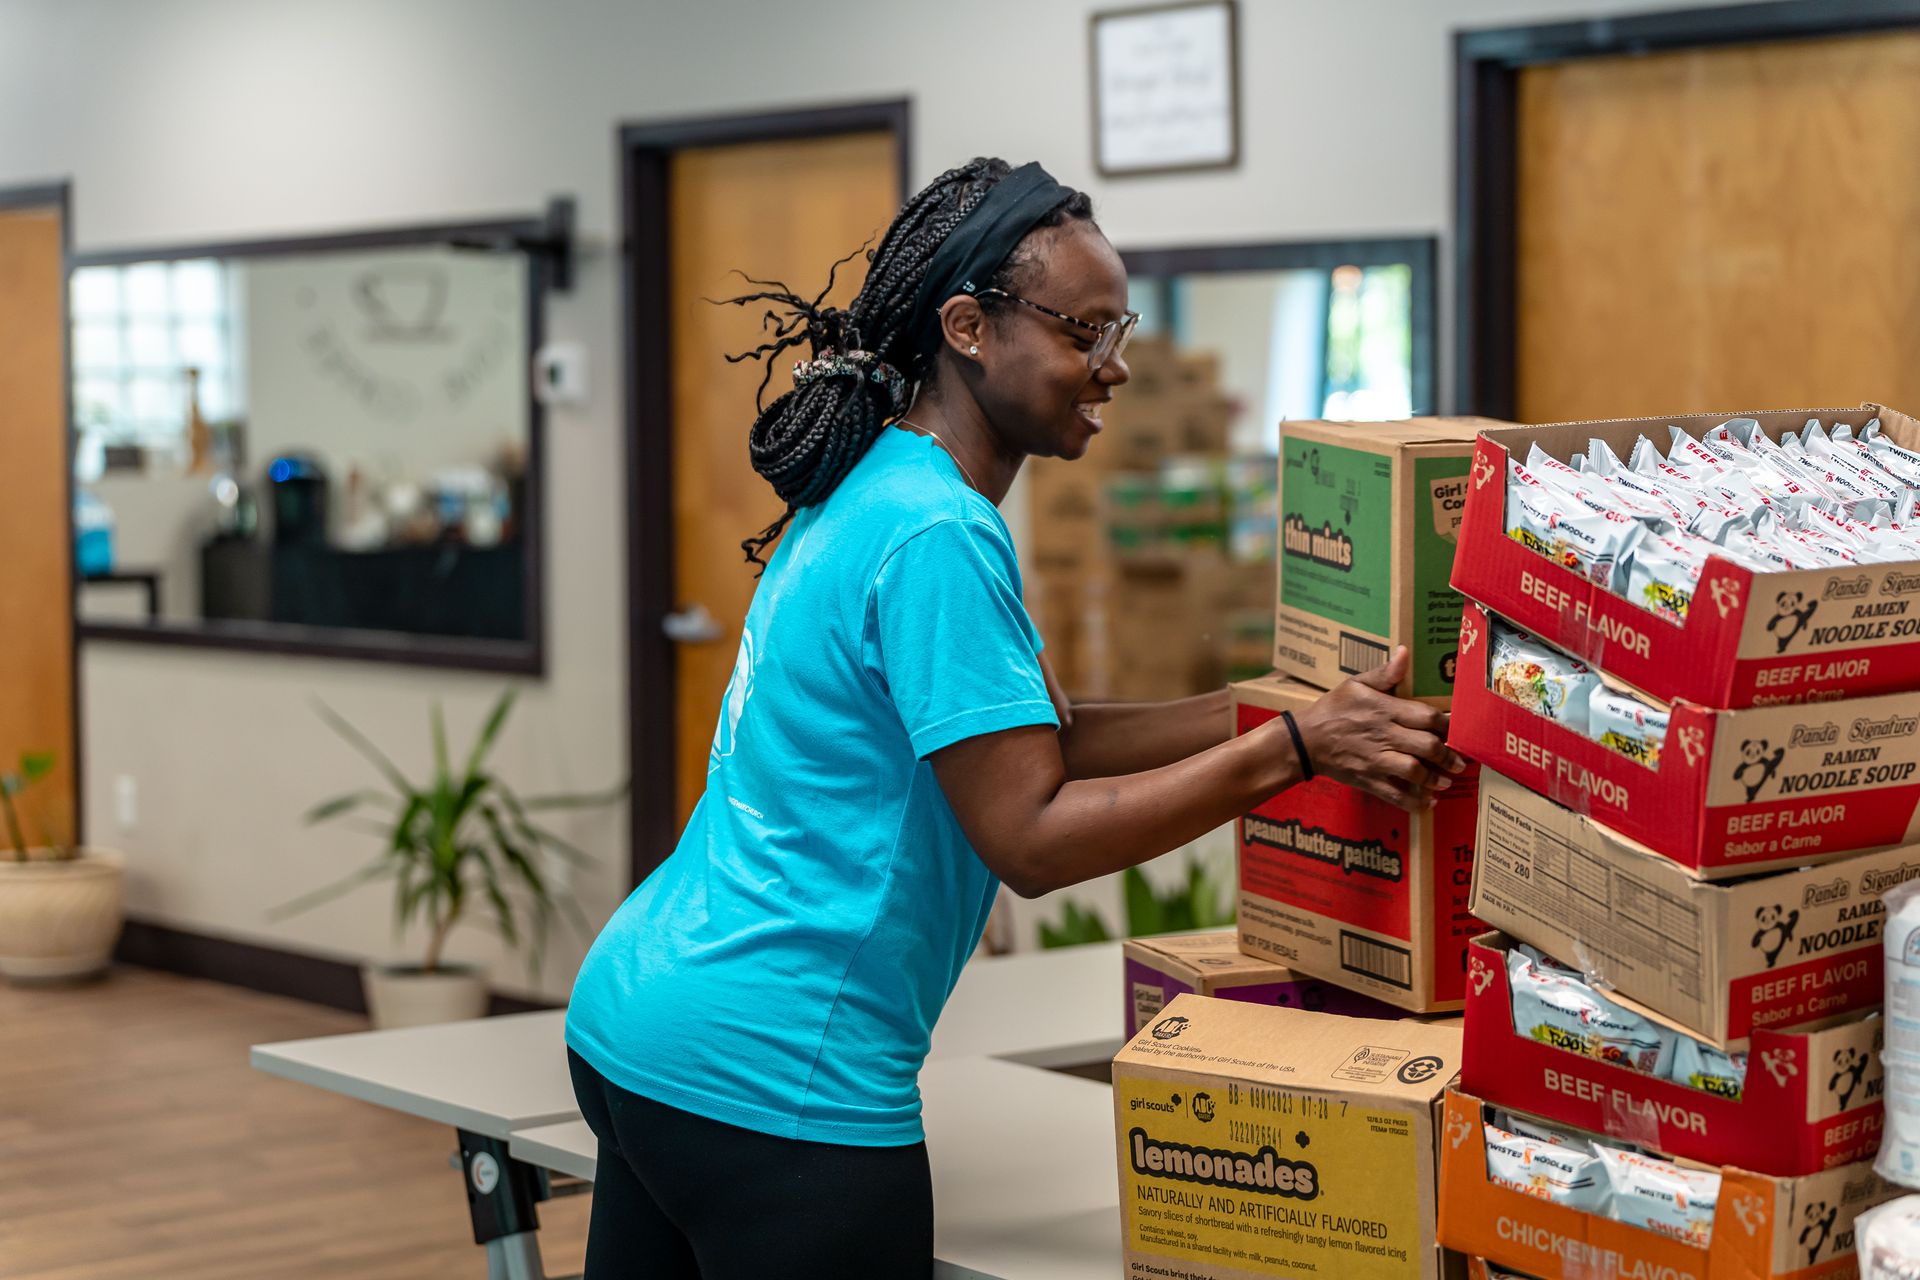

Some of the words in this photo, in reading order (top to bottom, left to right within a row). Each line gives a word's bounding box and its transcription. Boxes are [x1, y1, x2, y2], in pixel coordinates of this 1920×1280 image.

[1686, 443, 1718, 464] BEEF
[1889, 446, 1920, 467] TWISTE
[1434, 483, 1461, 498] Girl
[1285, 516, 1311, 556] thin
[1311, 525, 1352, 567] mints
[1559, 522, 1596, 544] NOODLES
[1823, 576, 1872, 601] Panda
[1880, 573, 1920, 597] Signa
[1520, 571, 1571, 613] BEEF
[1575, 600, 1651, 659] FLAVOR
[1852, 601, 1909, 619] RAMEN
[1808, 622, 1889, 646] NOODLE
[1755, 666, 1802, 688] BEEF
[1804, 659, 1870, 682] FLAVOR
[1789, 723, 1839, 748] Panda
[1849, 716, 1918, 743] Signature
[1506, 731, 1552, 771] BEEF
[1557, 757, 1629, 812] FLAVOR
[1821, 747, 1881, 767] RAMEN
[1779, 768, 1861, 794] NOODLE
[1864, 762, 1916, 784] SOUP
[1490, 802, 1515, 822] Nutrition
[1516, 817, 1532, 832] Facts
[1727, 812, 1774, 835] BEEF
[1777, 804, 1846, 829] FLAVOR
[1245, 818, 1293, 846] peanut
[1295, 825, 1341, 859] butter
[1344, 845, 1400, 876] patties
[1724, 841, 1765, 858] Sabor
[1769, 839, 1778, 852] a
[1782, 835, 1822, 850] Carne
[1487, 850, 1511, 869] Calories
[1515, 861, 1530, 879] 280
[1802, 878, 1850, 908] Panda
[1860, 864, 1920, 895] Signatur
[1798, 920, 1879, 955] NOODLE
[1752, 977, 1797, 1004] BEEF
[1801, 960, 1868, 992] FLAVOR
[1540, 999, 1578, 1017] TWISTED
[1752, 1006, 1792, 1026] Sabor
[1796, 1004, 1804, 1016] a
[1808, 993, 1847, 1013] Carne
[1131, 1044, 1154, 1053] baked
[1164, 1049, 1175, 1057] the
[1176, 1051, 1208, 1061] authority
[1217, 1056, 1231, 1064] Girl
[1230, 1058, 1255, 1067] Scouts
[1267, 1062, 1279, 1070] the
[1151, 1041, 1172, 1049] Scout
[1130, 1098, 1145, 1110] girl
[1146, 1101, 1174, 1113] scouts
[1228, 1083, 1243, 1105] BB:
[1250, 1087, 1293, 1115] 09012023
[1302, 1095, 1328, 1120] 07:28
[1340, 1101, 1349, 1118] 7
[1544, 1068, 1605, 1103] BEEF
[1611, 1088, 1708, 1136] FLAVOR
[1824, 1120, 1859, 1147] BEEF
[1133, 1133, 1314, 1194] lemonades
[1534, 1155, 1573, 1173] NOODLES
[1137, 1185, 1204, 1209] NATURALLY
[1208, 1197, 1235, 1214] AND
[1239, 1201, 1317, 1229] ARTIFICIALLY
[1322, 1214, 1387, 1239] FLAVORED
[1138, 1206, 1162, 1220] Savory
[1164, 1211, 1183, 1222] slices
[1186, 1213, 1193, 1223] of
[1195, 1215, 1234, 1230] shortbread
[1236, 1222, 1253, 1233] with
[1261, 1226, 1304, 1244] refreshingly
[1306, 1234, 1327, 1249] tangy
[1329, 1236, 1352, 1250] lemon
[1355, 1241, 1386, 1256] flavored
[1387, 1247, 1407, 1262] icing
[1139, 1224, 1165, 1235] Contains:
[1496, 1216, 1599, 1266] CHICKEN
[1140, 1233, 1179, 1248] Manufactured
[1192, 1243, 1211, 1253] shared
[1212, 1246, 1231, 1258] facility
[1264, 1255, 1290, 1268] peanuts,
[1131, 1263, 1144, 1271] Girl
[1146, 1265, 1169, 1276] Scouts
[1170, 1269, 1189, 1280] bring
